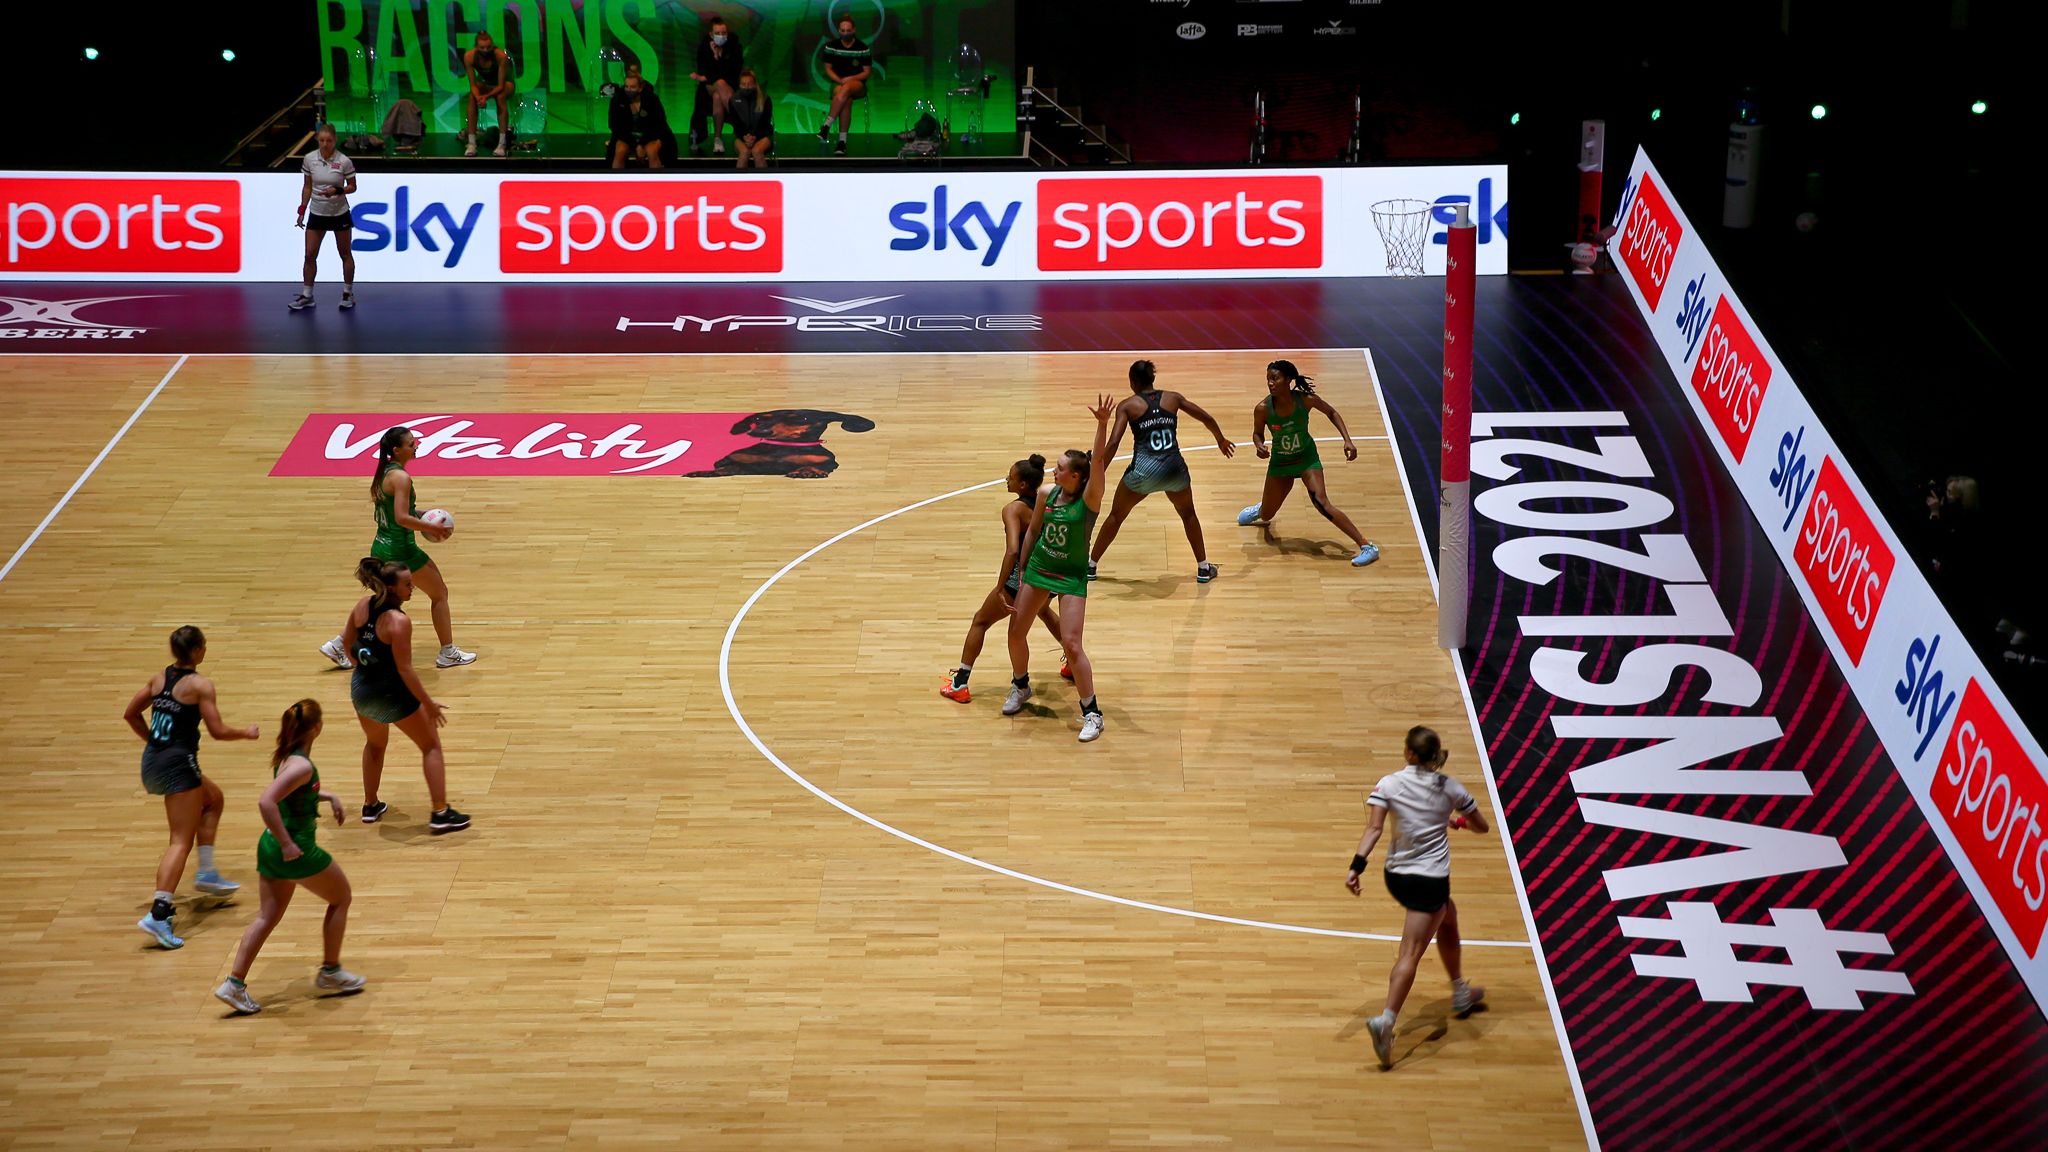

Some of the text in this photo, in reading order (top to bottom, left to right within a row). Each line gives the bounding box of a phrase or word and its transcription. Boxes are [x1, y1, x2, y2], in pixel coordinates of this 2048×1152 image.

[0, 194, 225, 263] ports
[351, 185, 766, 268] sky sports
[888, 185, 1306, 267] sky sports
[1627, 197, 1672, 286] sports
[615, 314, 1043, 337] HYPERICE
[1676, 273, 1760, 433] sky sports
[1150, 428, 1173, 451] GD
[1281, 433, 1301, 451] GA
[1045, 522, 1068, 547] GS
[1769, 426, 1879, 631] sky sports
[1895, 634, 2048, 911] sky sports
